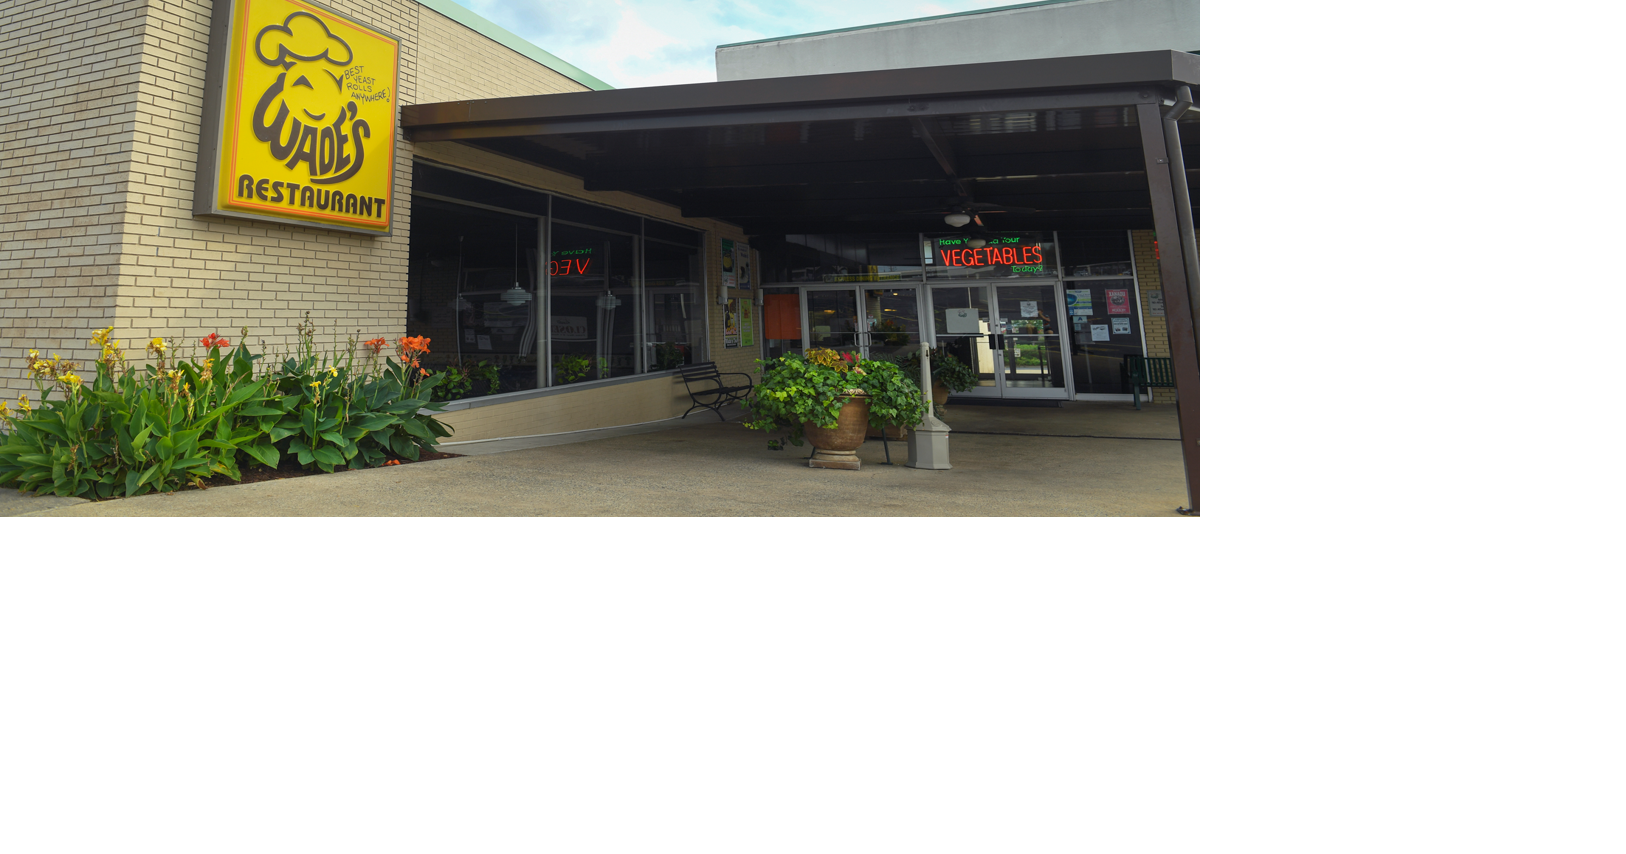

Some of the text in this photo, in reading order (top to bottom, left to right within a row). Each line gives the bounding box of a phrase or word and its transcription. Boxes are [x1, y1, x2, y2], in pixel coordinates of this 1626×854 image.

[344, 65, 364, 80] BEST
[353, 76, 376, 86] YEAST
[346, 82, 372, 92] ROLLS
[252, 72, 370, 184] WADE'S
[238, 174, 386, 218] RESTAURANT
[940, 246, 1042, 266] VEGETABLES
